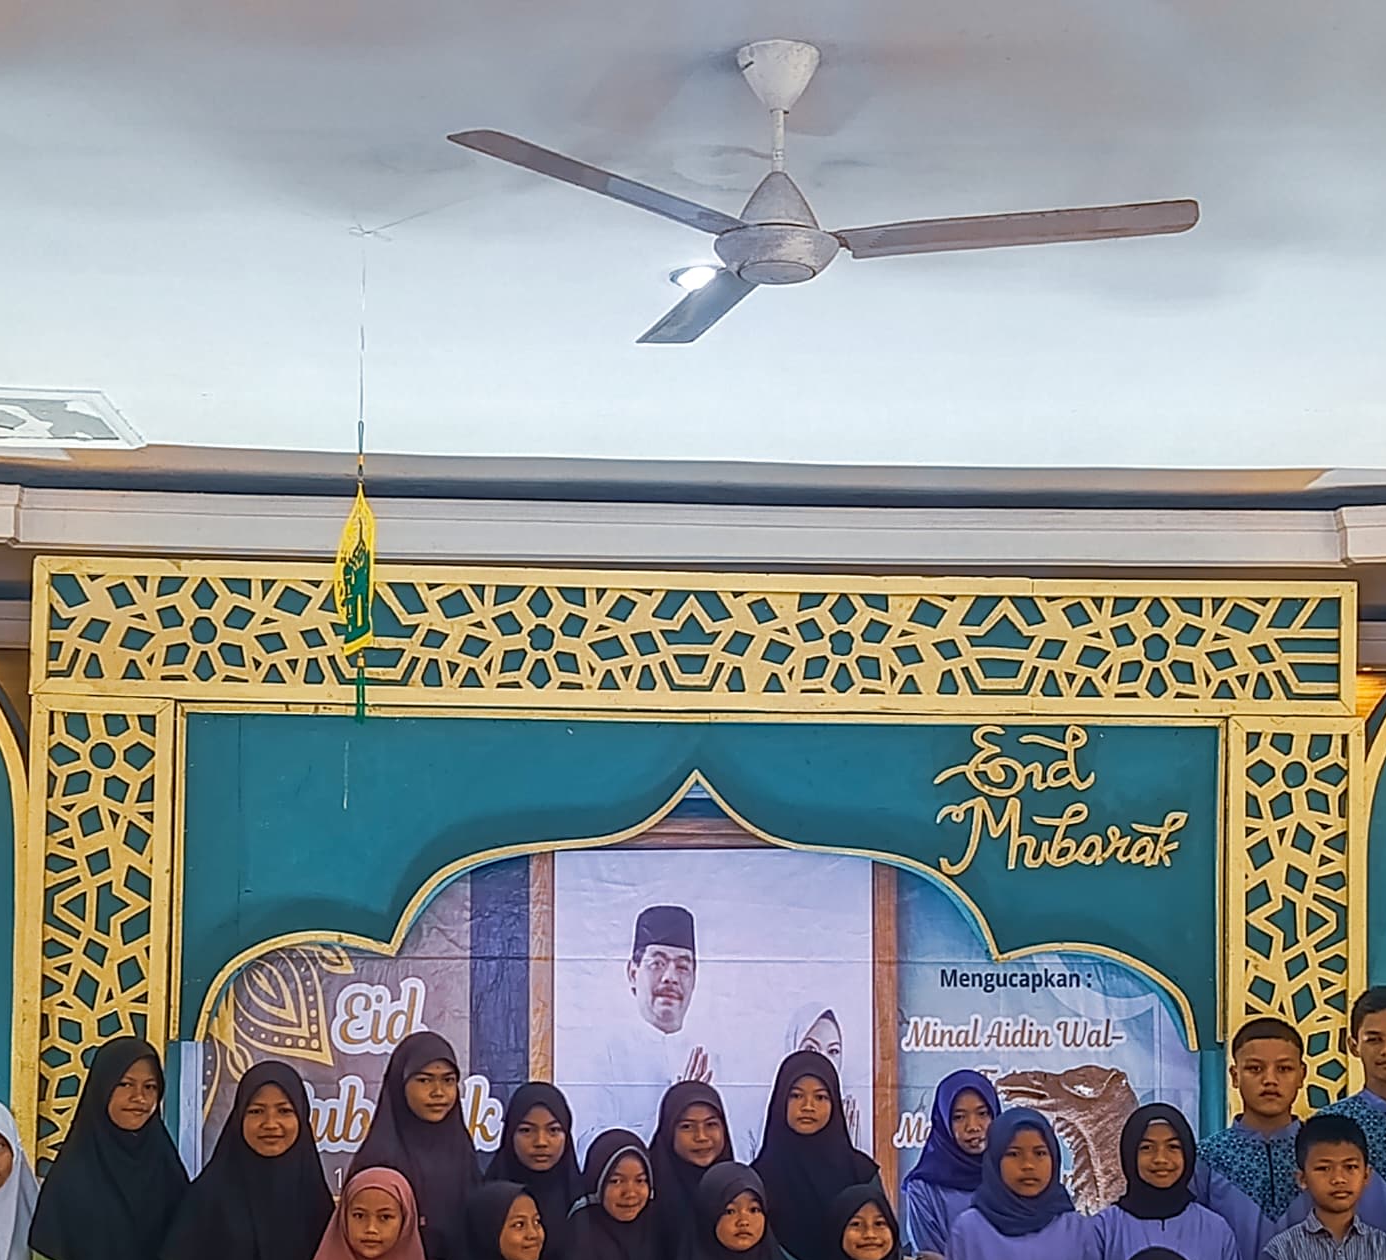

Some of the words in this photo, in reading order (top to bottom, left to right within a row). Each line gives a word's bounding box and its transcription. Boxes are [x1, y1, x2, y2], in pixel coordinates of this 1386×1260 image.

[936, 796, 1189, 876] Mubarak
[939, 968, 1081, 993] Mengucapkan
[339, 984, 416, 1046] Eid
[905, 1017, 981, 1049] Minal
[983, 1016, 1054, 1049] Aidin
